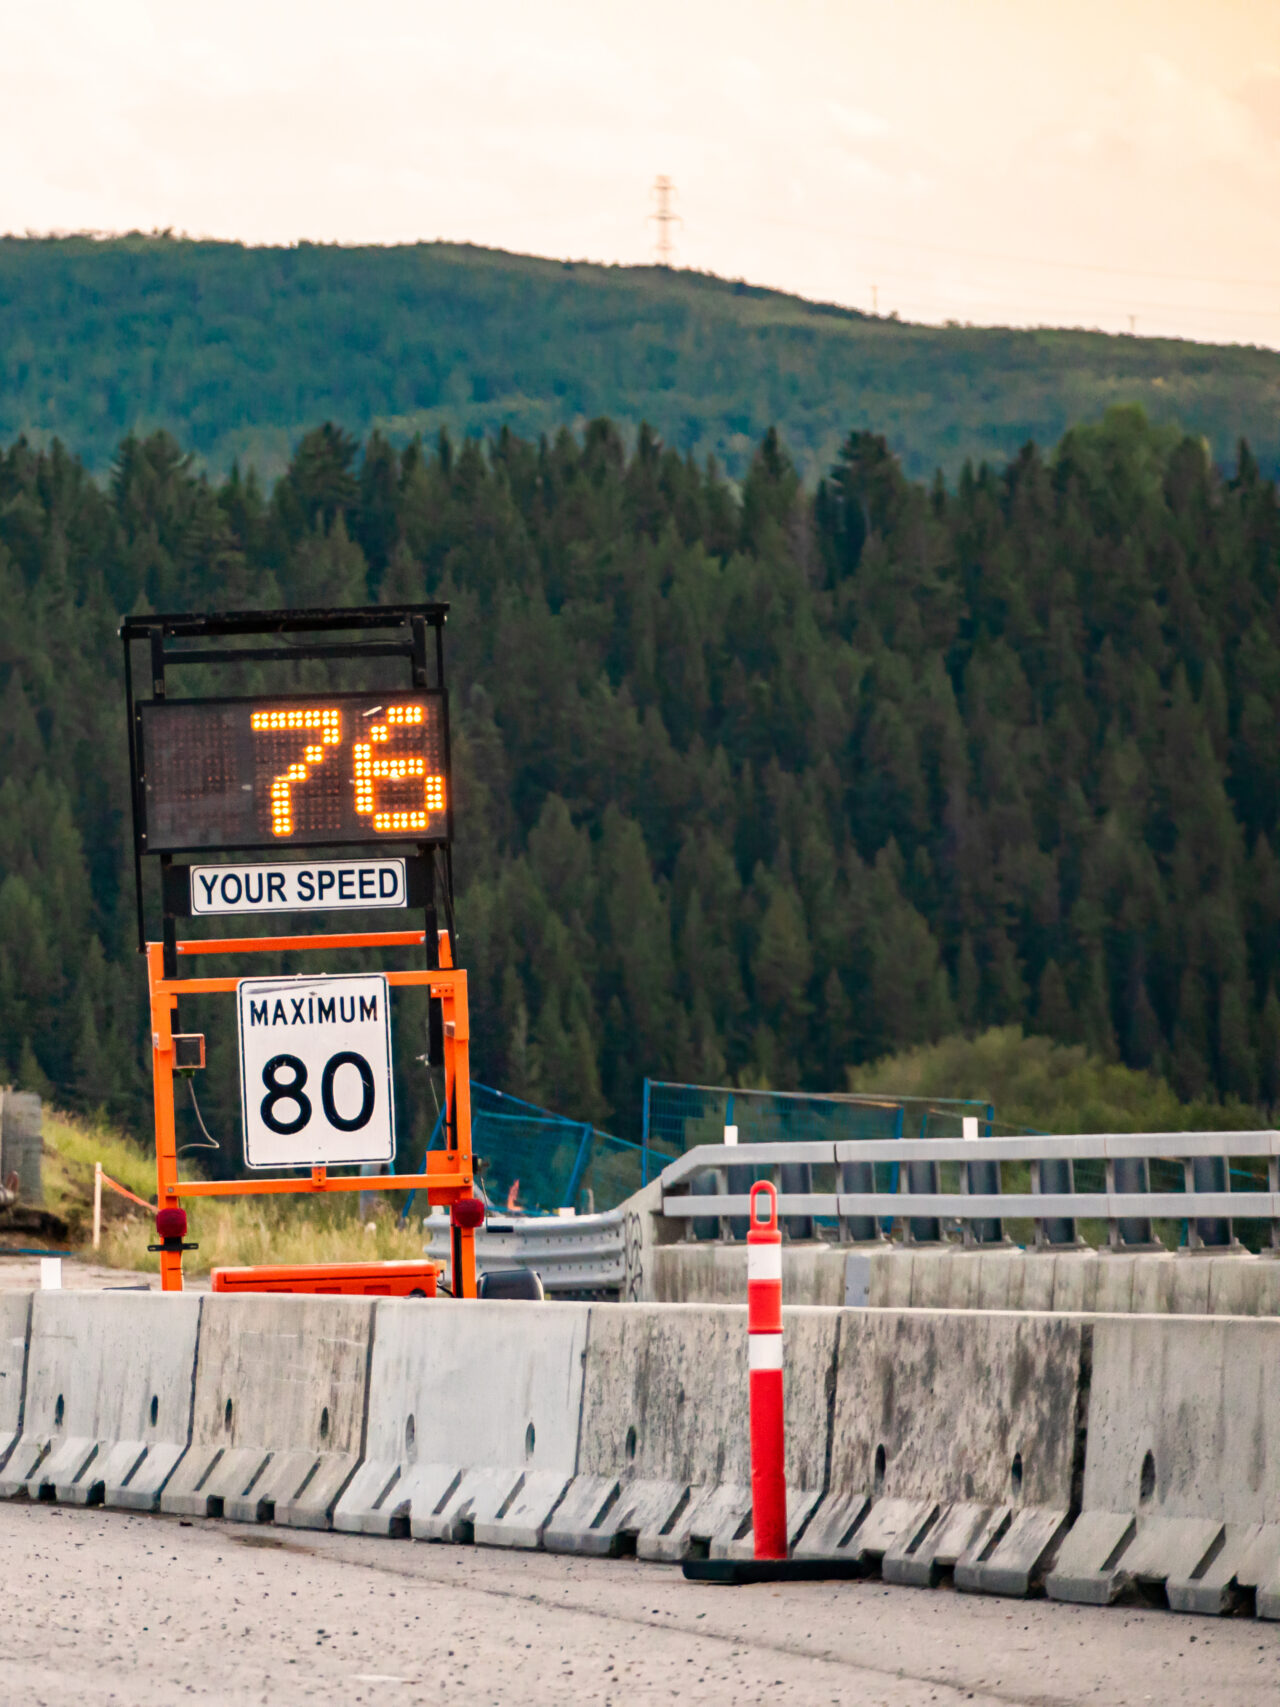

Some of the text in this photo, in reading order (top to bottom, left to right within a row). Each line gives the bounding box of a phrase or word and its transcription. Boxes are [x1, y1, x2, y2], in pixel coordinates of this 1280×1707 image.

[251, 706, 446, 836] 76
[199, 868, 398, 905] YOUR SPEED
[250, 995, 378, 1026] MAXIMUM
[260, 1051, 375, 1135] 80
